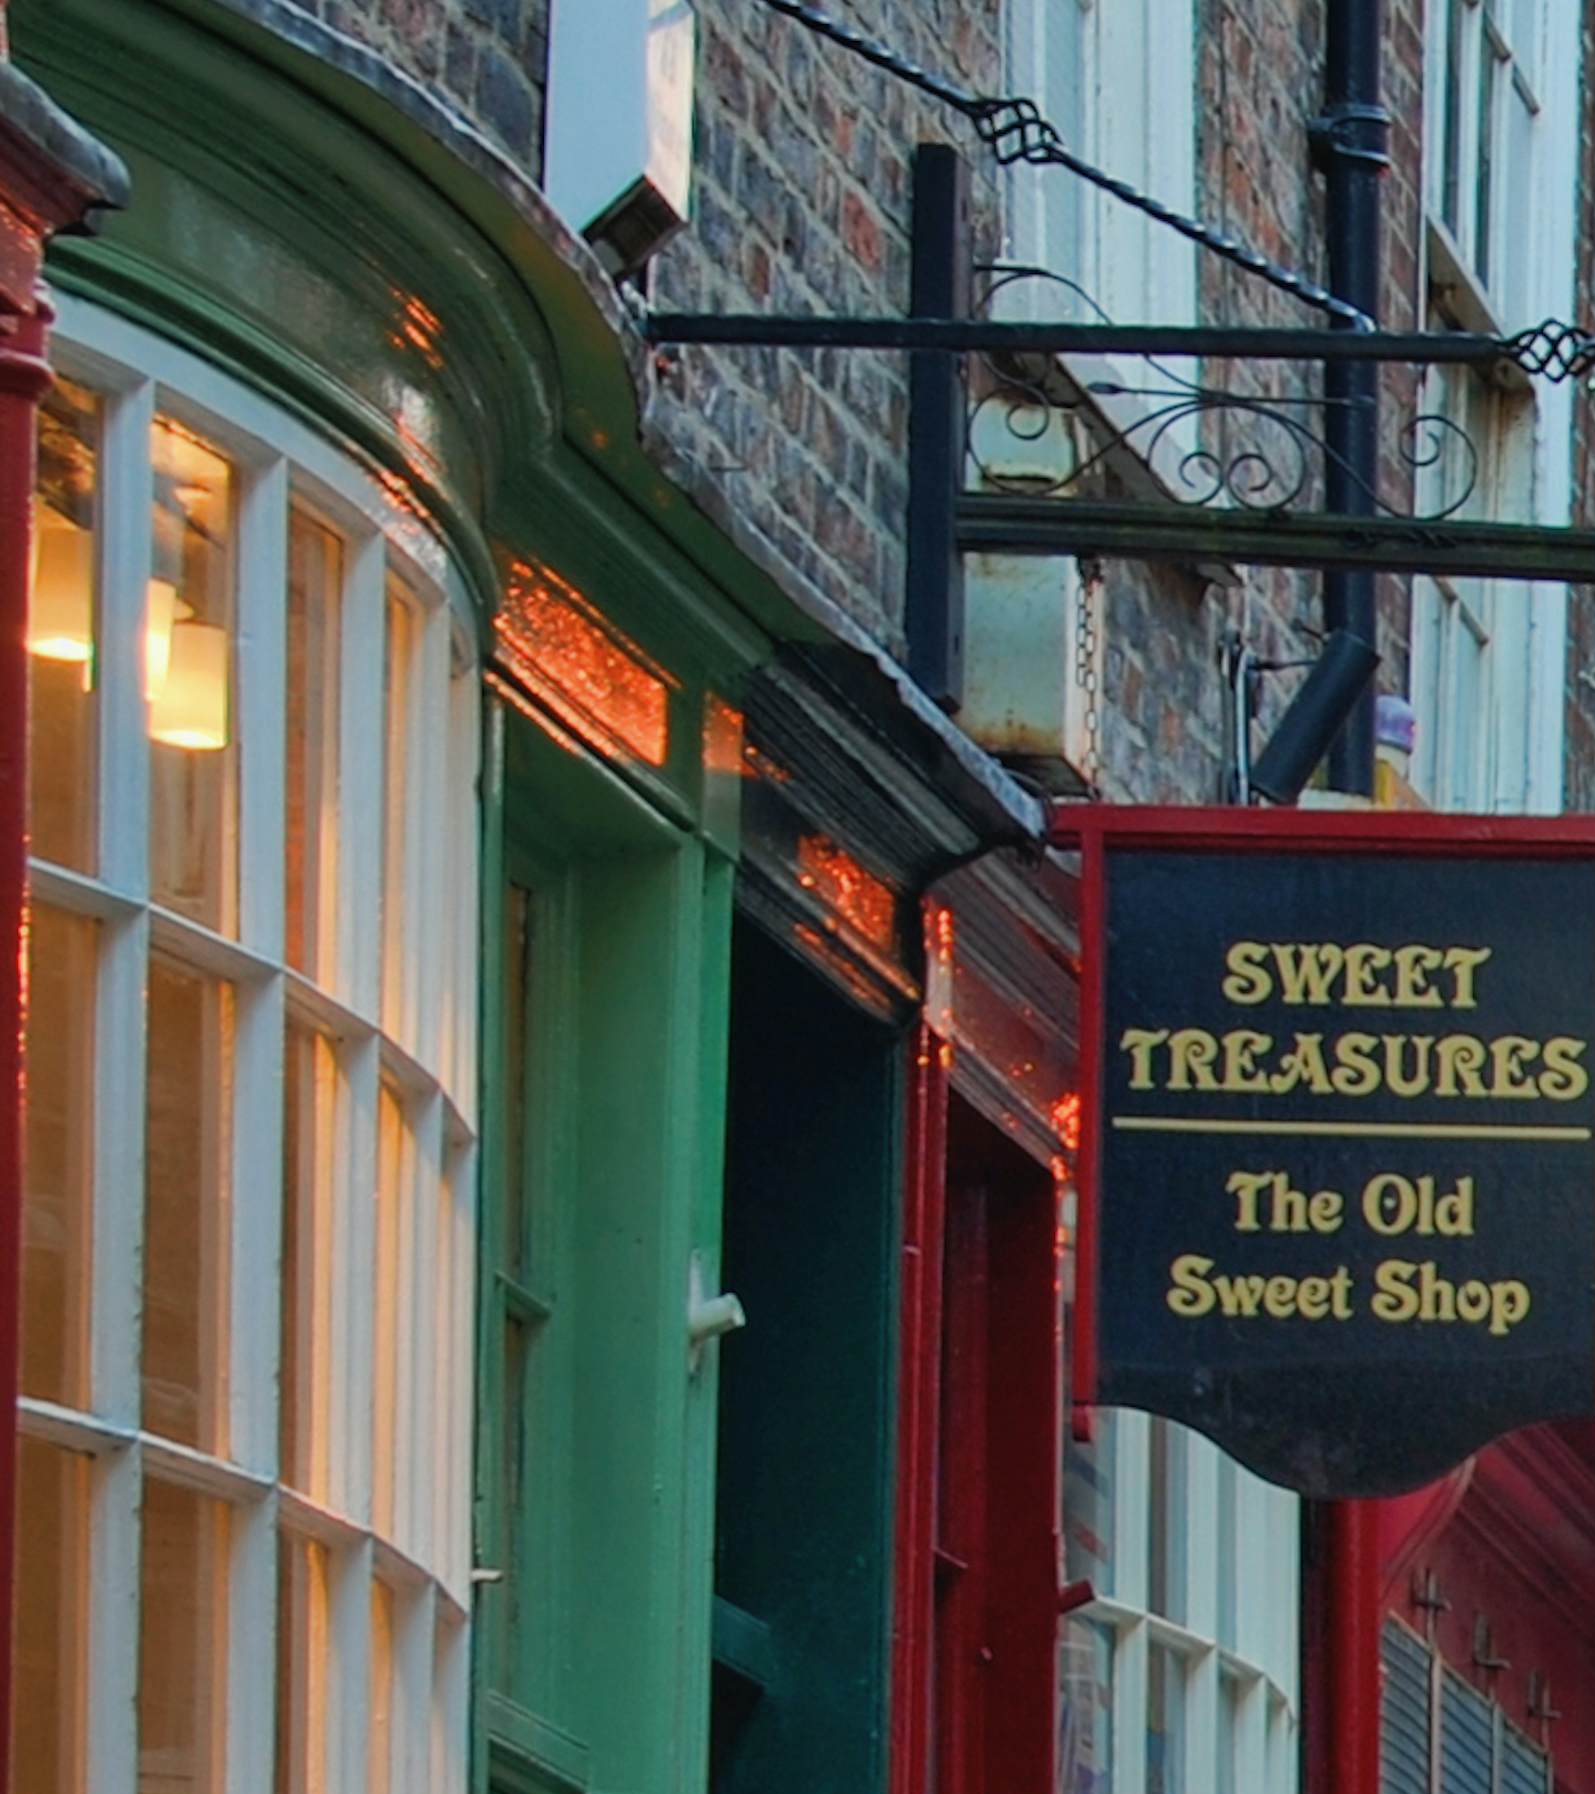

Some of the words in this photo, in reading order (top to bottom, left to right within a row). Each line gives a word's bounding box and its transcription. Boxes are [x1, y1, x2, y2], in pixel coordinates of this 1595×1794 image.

[1222, 942, 1491, 1009] SWEET
[1120, 1028, 1589, 1100] TREASURES
[1226, 1171, 1344, 1233] The
[1362, 1173, 1474, 1237] Old
[1166, 1255, 1353, 1319] Sweet
[1370, 1259, 1531, 1335] Shop
